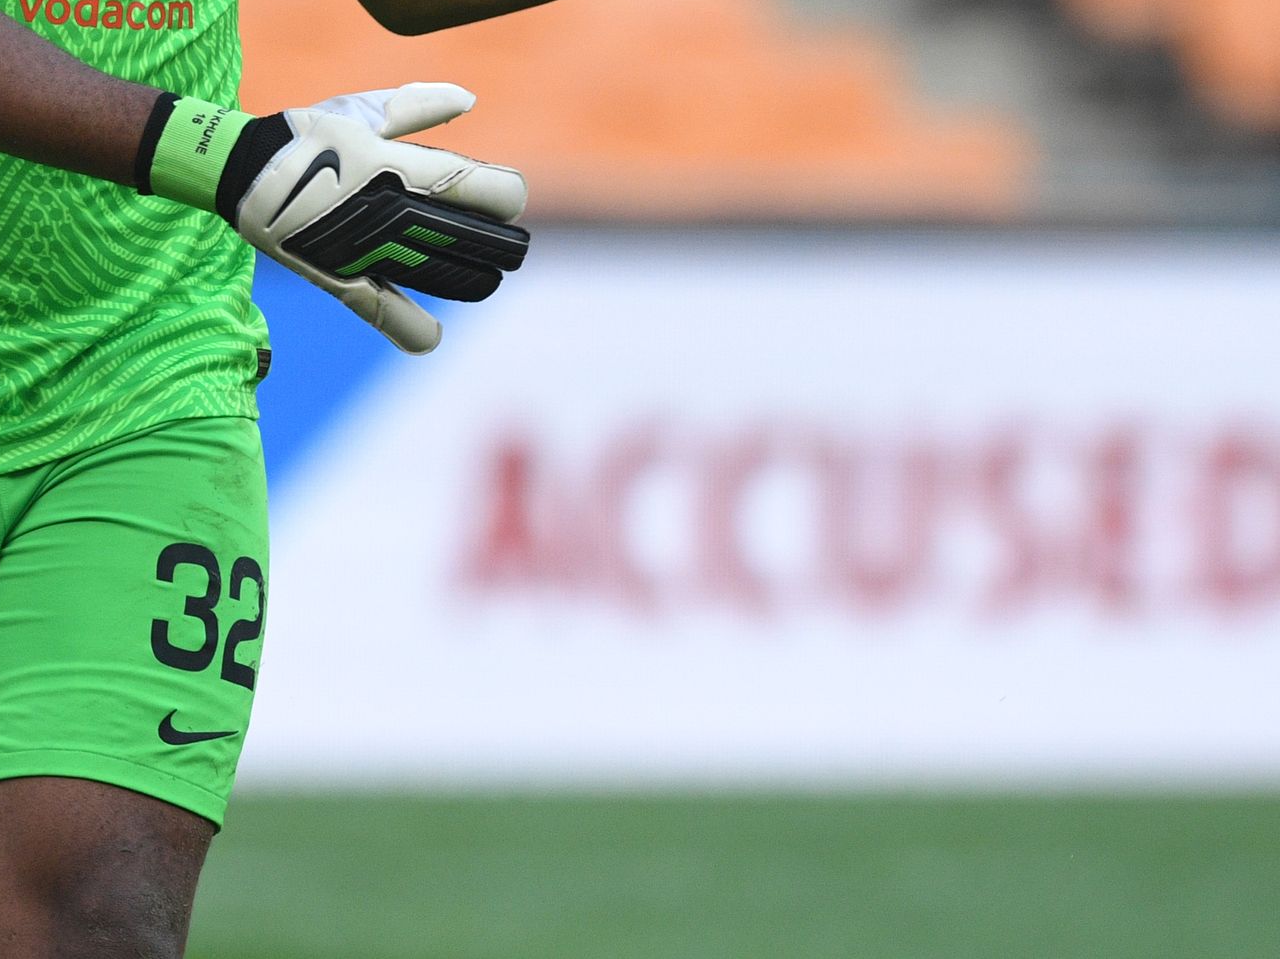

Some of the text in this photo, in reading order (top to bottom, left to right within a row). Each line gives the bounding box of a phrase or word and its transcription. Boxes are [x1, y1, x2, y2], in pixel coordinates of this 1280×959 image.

[195, 115, 223, 156] KHUNE
[458, 428, 1280, 610] ACCUSED
[150, 542, 264, 692] 32
